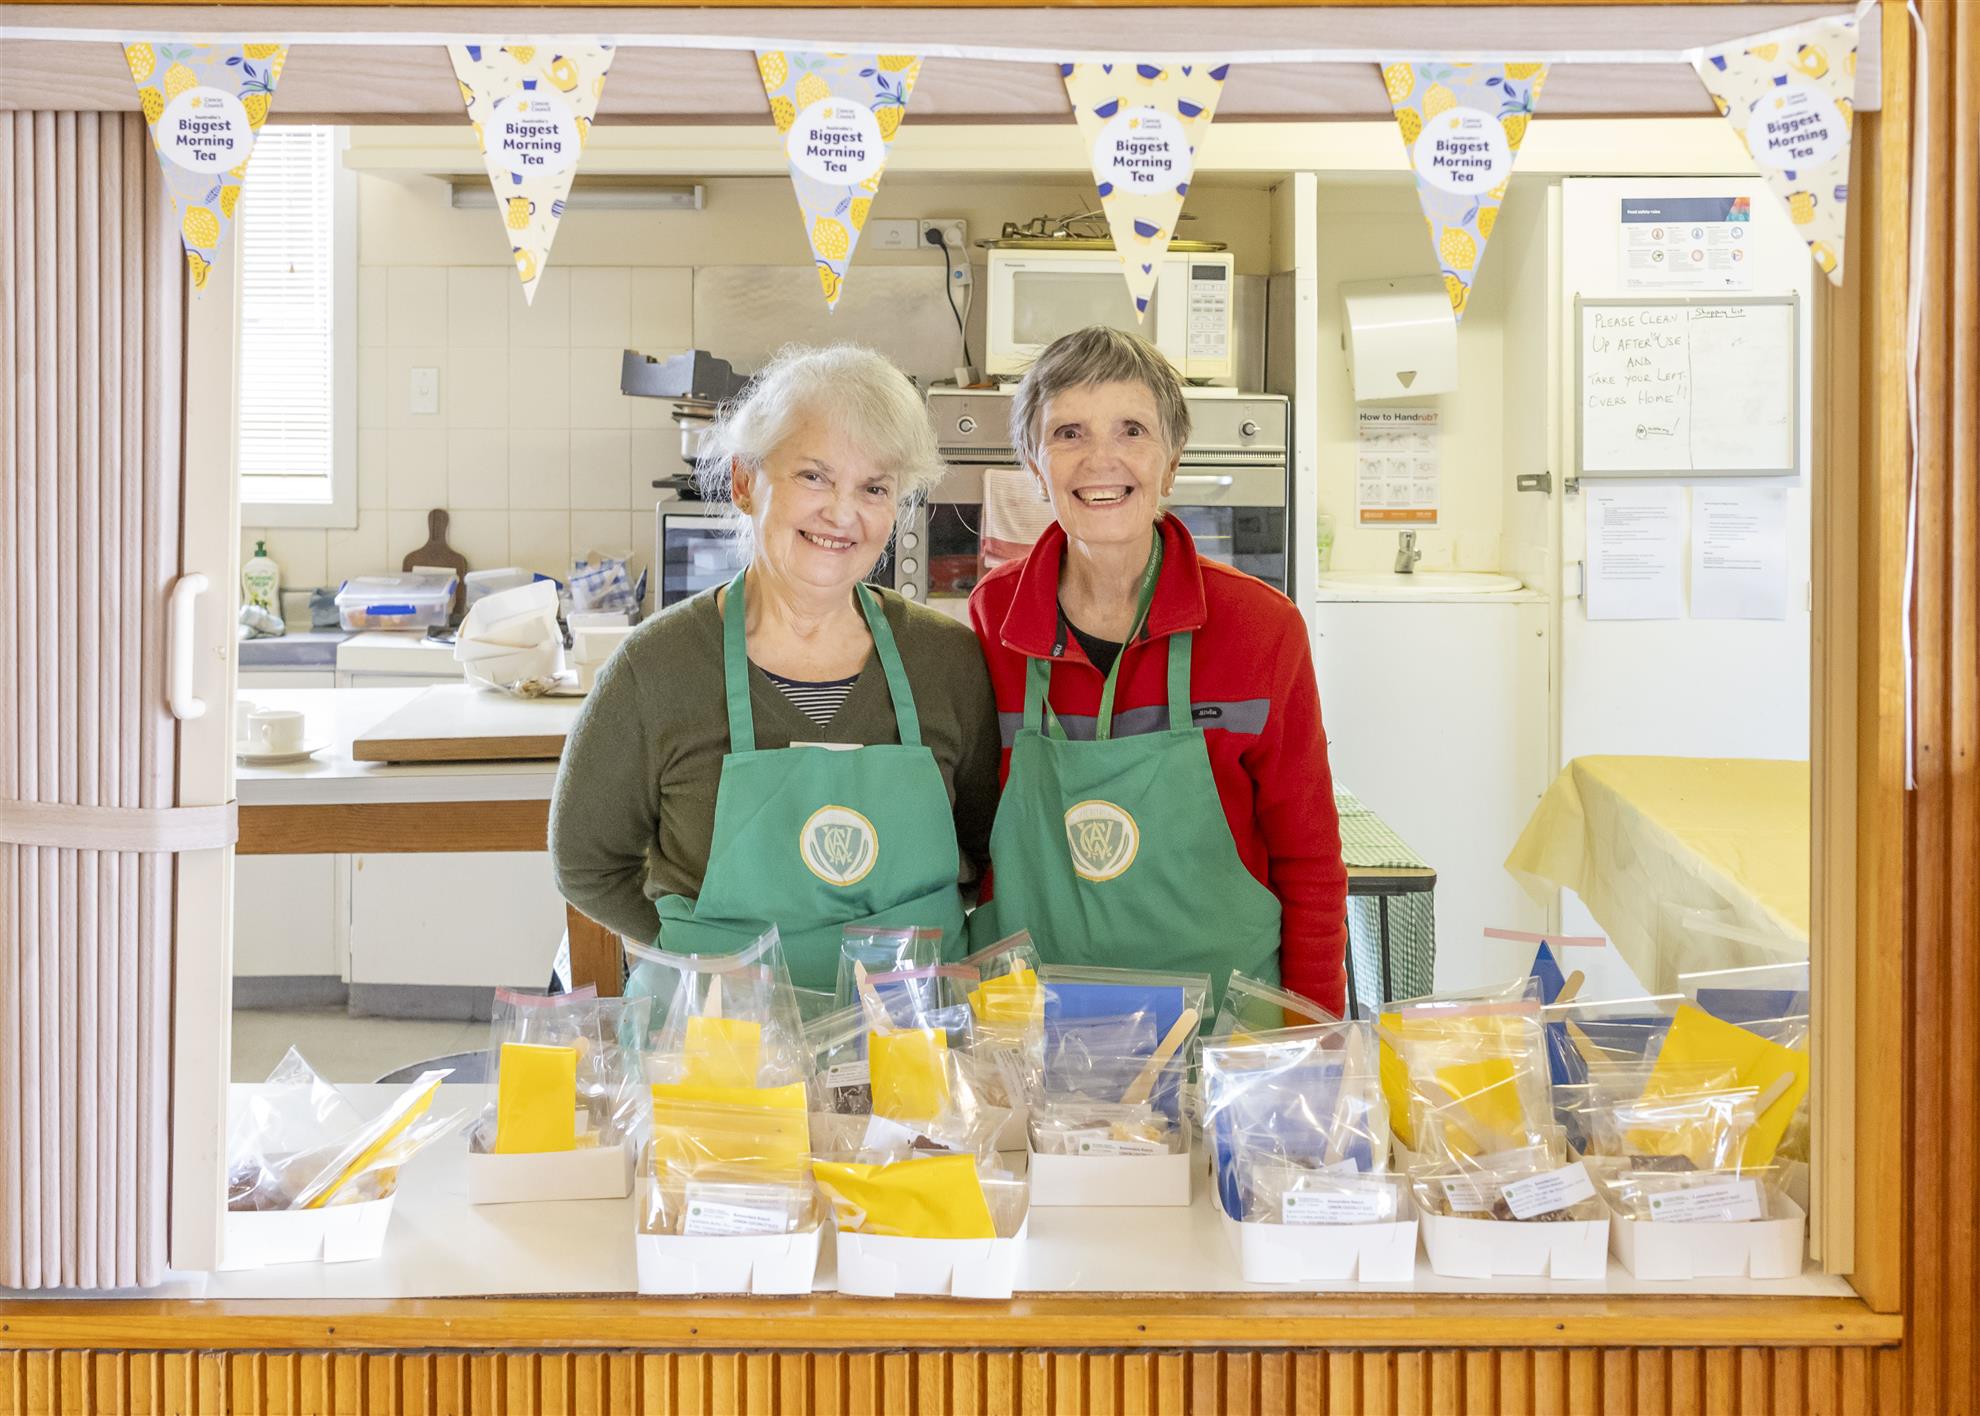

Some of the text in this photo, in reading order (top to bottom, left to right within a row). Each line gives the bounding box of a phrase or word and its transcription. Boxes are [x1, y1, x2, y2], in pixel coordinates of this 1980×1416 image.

[179, 119, 231, 134] Biggest
[506, 123, 559, 138] Biggest
[1767, 112, 1821, 134] Biggest
[176, 134, 234, 149] Morning
[810, 129, 863, 144] Biggest
[1768, 128, 1828, 150] Morning
[504, 139, 561, 153] Morning
[807, 145, 865, 161] Morning
[1116, 140, 1169, 155] Biggest
[1436, 140, 1489, 155] Biggest
[1788, 148, 1814, 159] Tea
[193, 150, 216, 160] Tea
[520, 154, 544, 164] Tea
[1433, 155, 1492, 170] Morning
[824, 161, 847, 172] Tea
[1113, 156, 1172, 171] Morning
[1130, 171, 1154, 182] Tea
[1450, 171, 1474, 182] Tea
[1627, 357, 1652, 368] AND
